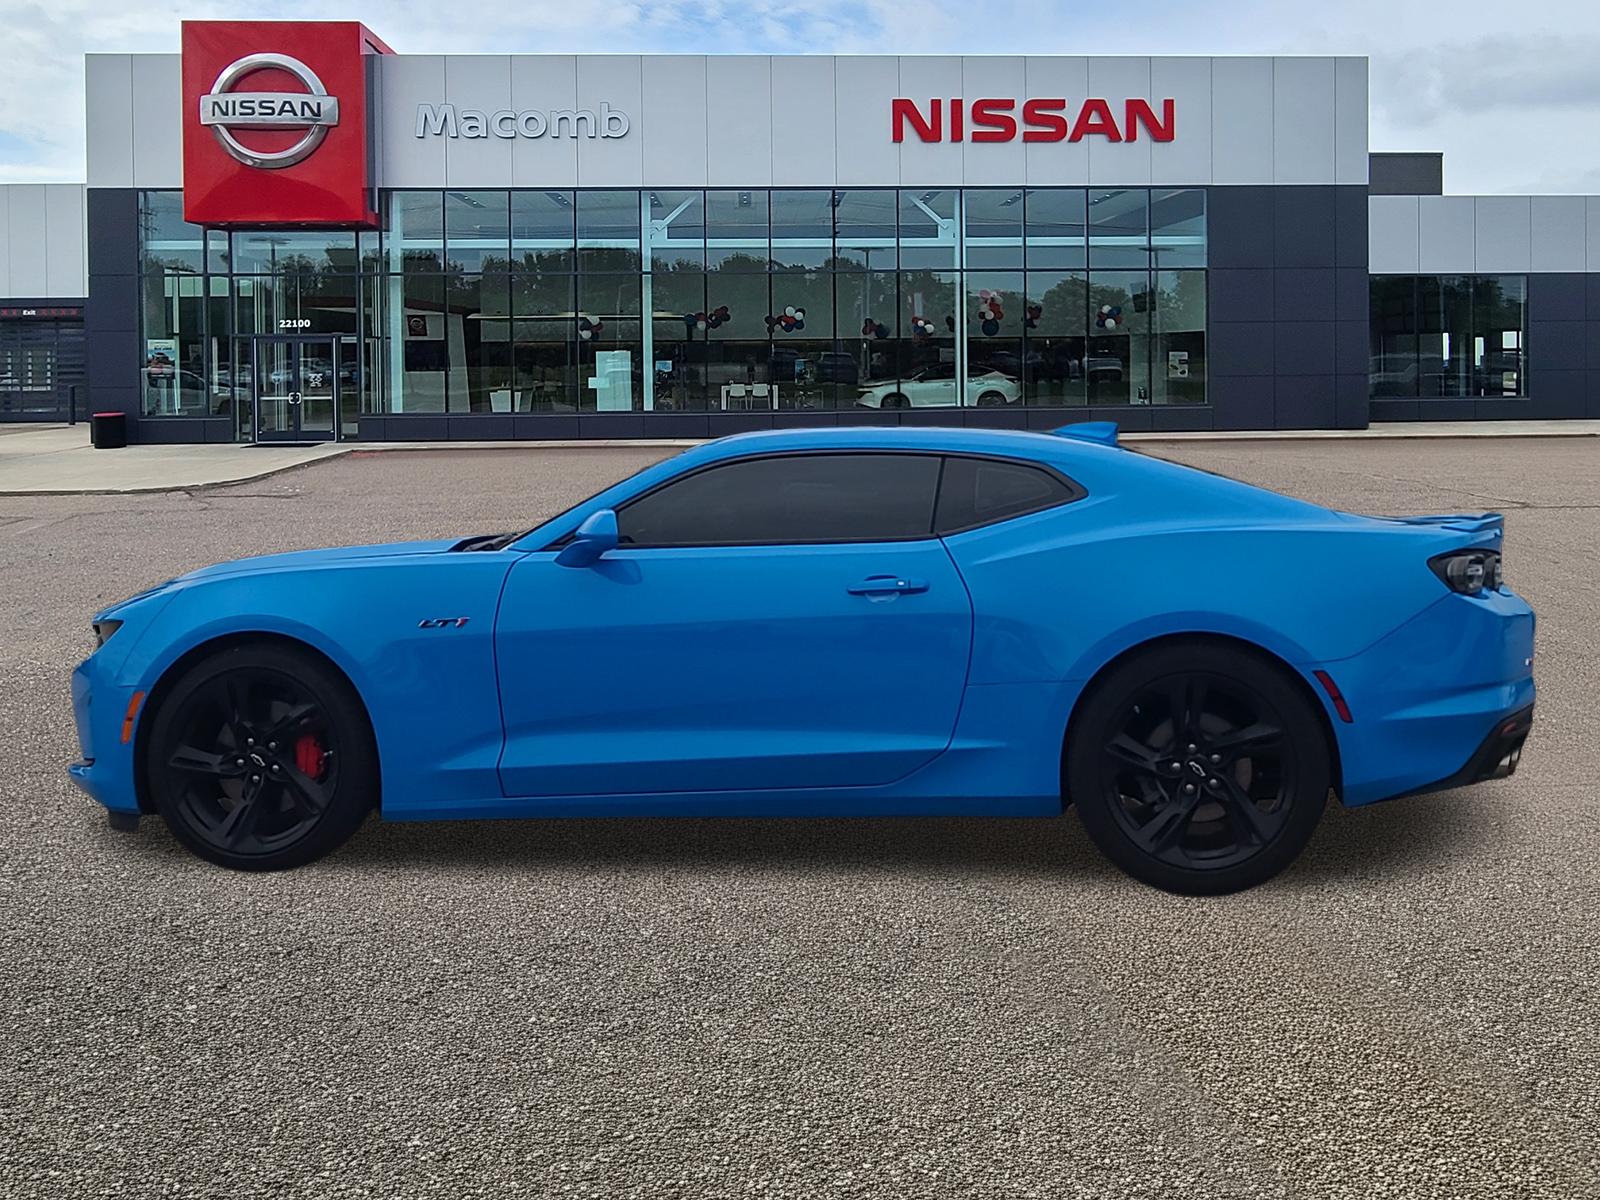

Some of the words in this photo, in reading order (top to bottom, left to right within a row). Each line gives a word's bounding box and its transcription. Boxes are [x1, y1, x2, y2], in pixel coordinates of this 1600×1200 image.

[211, 99, 323, 118] NISSAN
[414, 101, 630, 139] Macomb
[892, 97, 1175, 143] NISSAN
[279, 319, 311, 328] 22100
